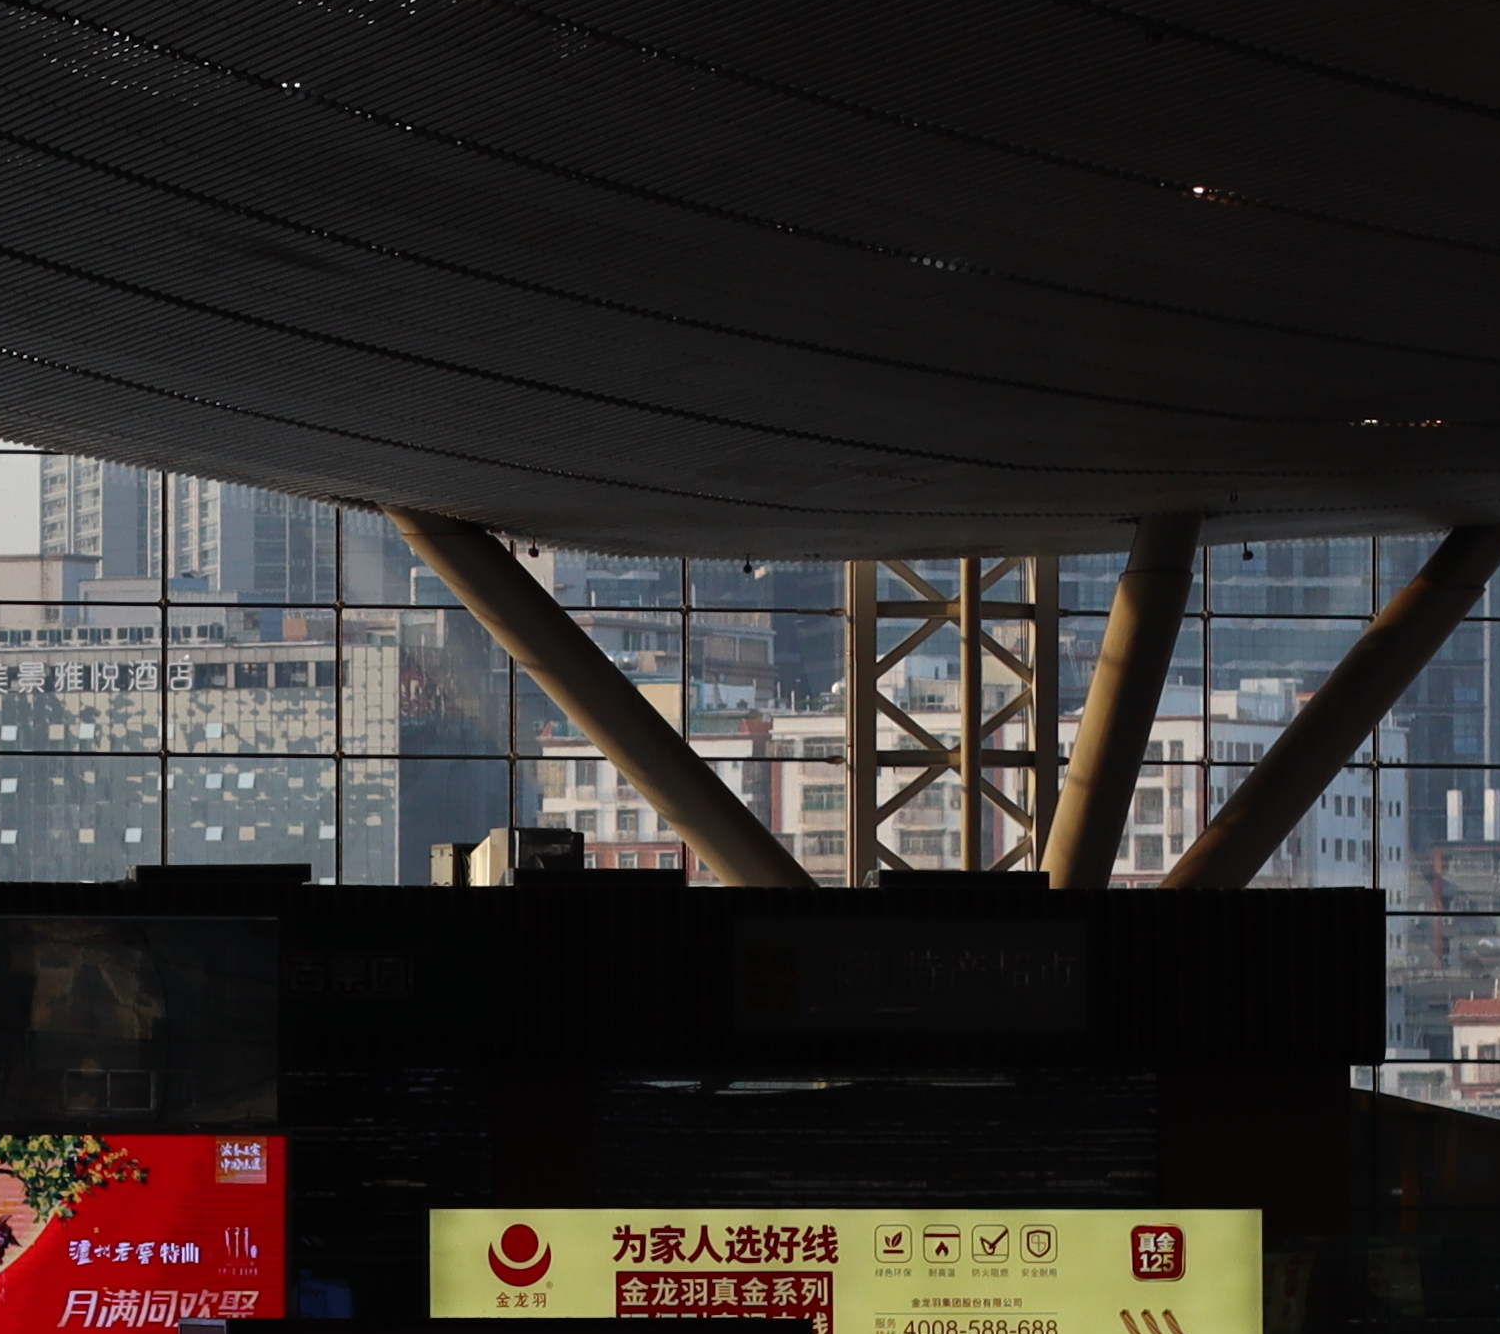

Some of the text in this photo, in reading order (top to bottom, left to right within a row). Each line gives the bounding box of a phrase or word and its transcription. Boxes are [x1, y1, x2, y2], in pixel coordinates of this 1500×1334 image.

[288, 955, 407, 993] 百果园
[68, 1238, 201, 1266] 泸州老窖特曲
[612, 1224, 840, 1265] 为家人选好线
[1137, 1231, 1176, 1253] 真金
[1139, 1253, 1175, 1273] 125
[495, 1292, 547, 1308] 金龙羽
[620, 1276, 829, 1307] 金龙羽真金系列
[911, 1297, 1023, 1309] 金龙羽集团股份有限公司
[56, 1288, 260, 1328] 月满同欢聚
